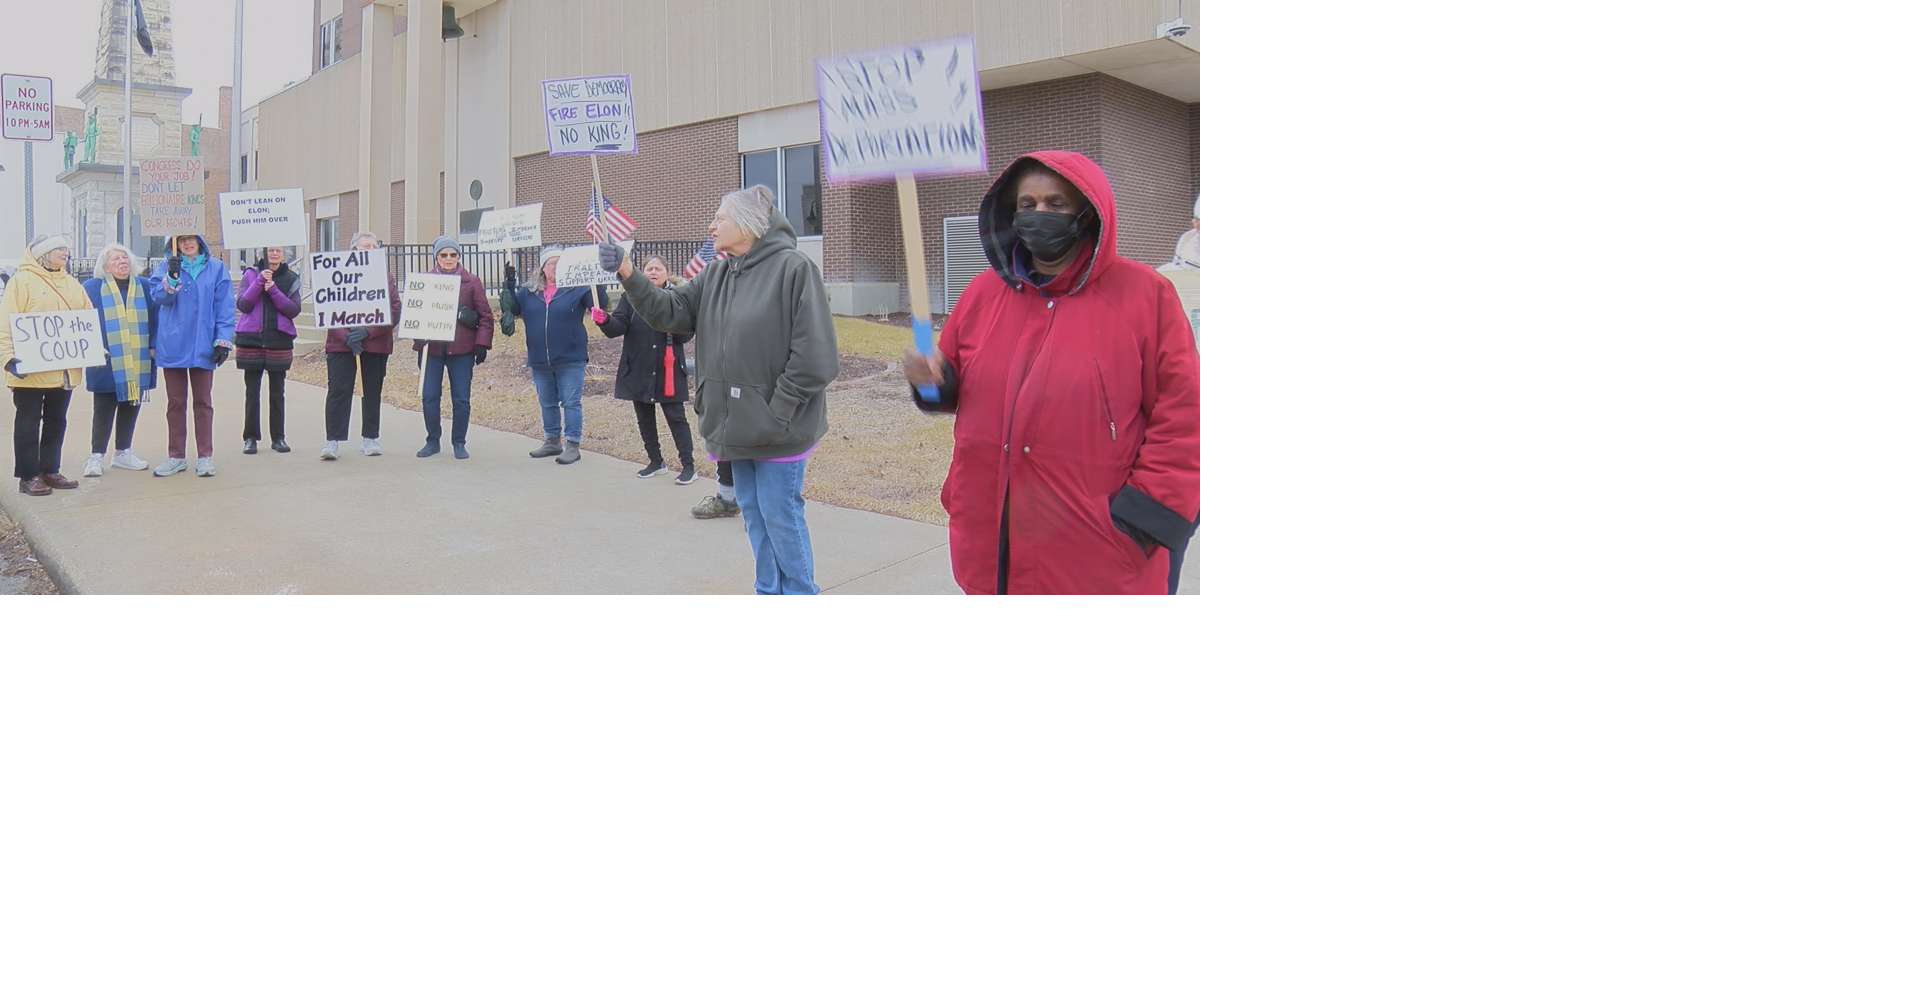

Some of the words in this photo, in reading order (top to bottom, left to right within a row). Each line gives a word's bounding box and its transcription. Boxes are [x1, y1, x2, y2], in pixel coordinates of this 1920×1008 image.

[18, 87, 37, 99] NO
[547, 83, 580, 99] SAVE
[5, 100, 50, 112] PARKING
[548, 106, 578, 122] FIRE
[6, 117, 17, 127] 10
[559, 127, 579, 146] NO
[587, 122, 628, 143] KING!
[140, 160, 181, 171] CONGRESS
[186, 160, 201, 171] DO
[149, 172, 169, 182] YOUR
[168, 181, 185, 193] LET
[141, 194, 185, 206] BILLIONAIRE
[230, 198, 252, 206] DON'T
[150, 206, 170, 216] TAKE
[173, 206, 193, 216] AWAY
[144, 219, 162, 228] OUR
[312, 254, 341, 270] For
[344, 250, 369, 267] All
[567, 263, 600, 272] TRAIT
[332, 270, 363, 286] Our
[558, 277, 595, 286] SUPPORT
[409, 281, 425, 290] NO
[433, 283, 454, 291] KING
[315, 286, 386, 304] Children
[407, 299, 423, 307] NO
[431, 302, 454, 310] MUSK
[318, 312, 325, 327] I
[330, 308, 385, 326] March
[15, 315, 64, 343] STOP
[69, 316, 93, 333] the
[404, 320, 420, 328] NO
[427, 322, 453, 330] PUTIN
[39, 338, 89, 362] COUP
